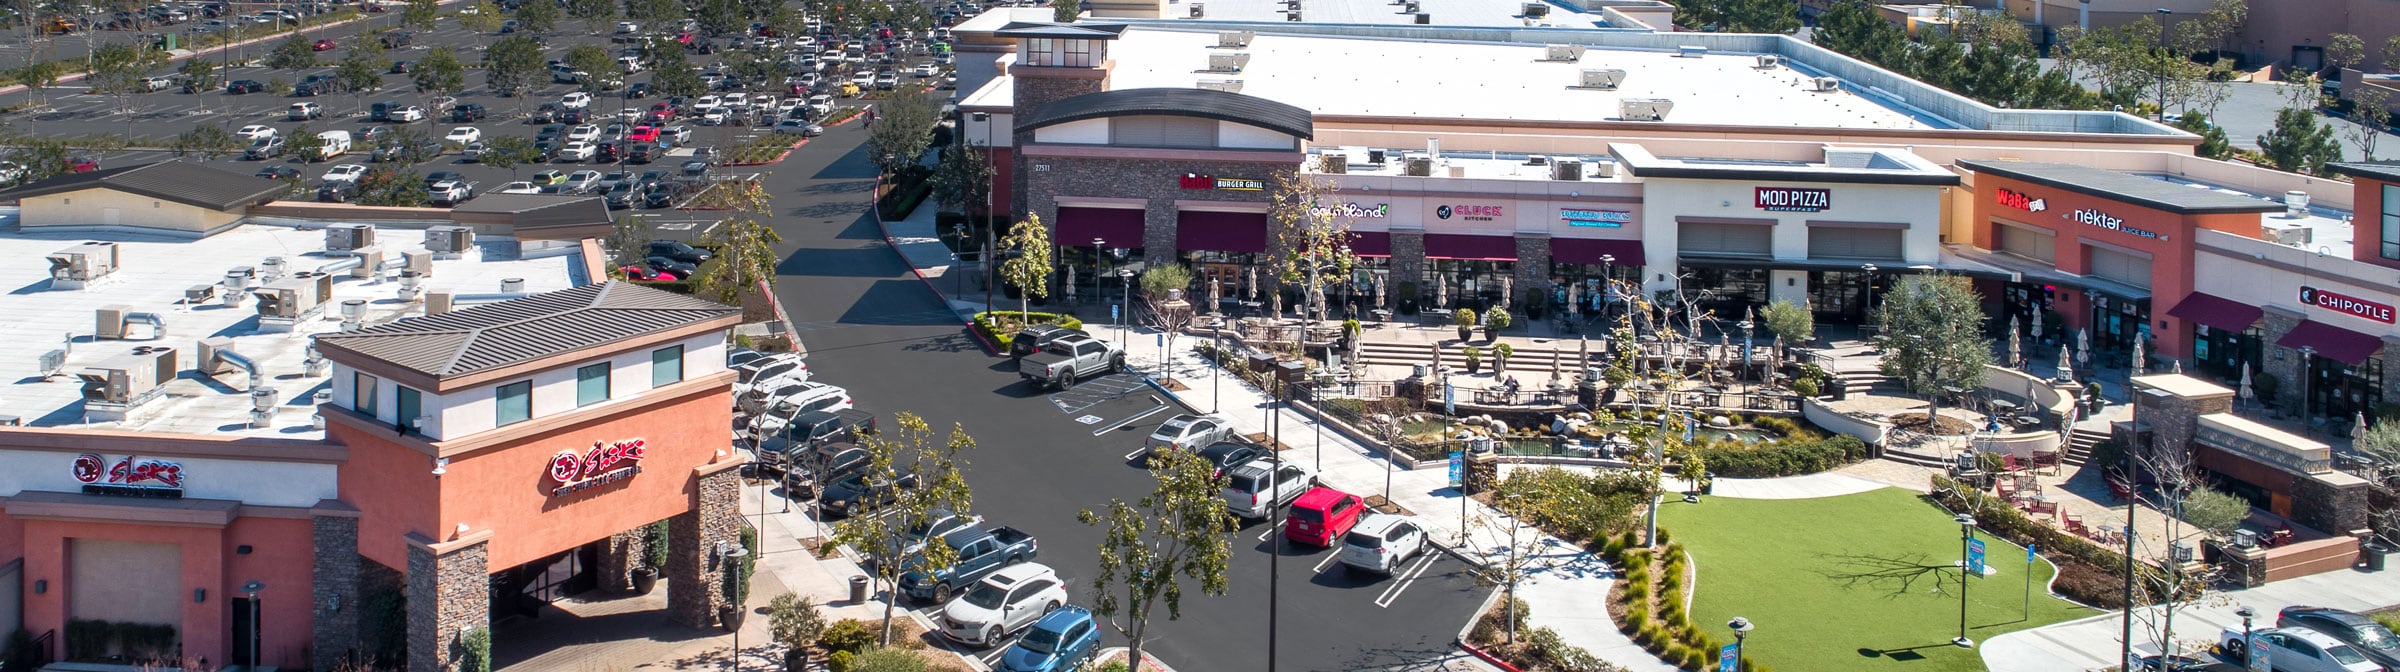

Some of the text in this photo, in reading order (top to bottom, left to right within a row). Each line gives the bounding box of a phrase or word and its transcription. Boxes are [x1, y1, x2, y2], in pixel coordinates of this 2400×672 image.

[1035, 164, 1050, 172] 27511
[1180, 175, 1212, 190] Habit
[1217, 180, 1244, 188] BURGER
[1759, 190, 1828, 207] MOD PIZZA
[1997, 188, 2030, 210] WaBa
[1455, 204, 1502, 217] CLUCK
[2319, 294, 2390, 321] CHIPOTLE
